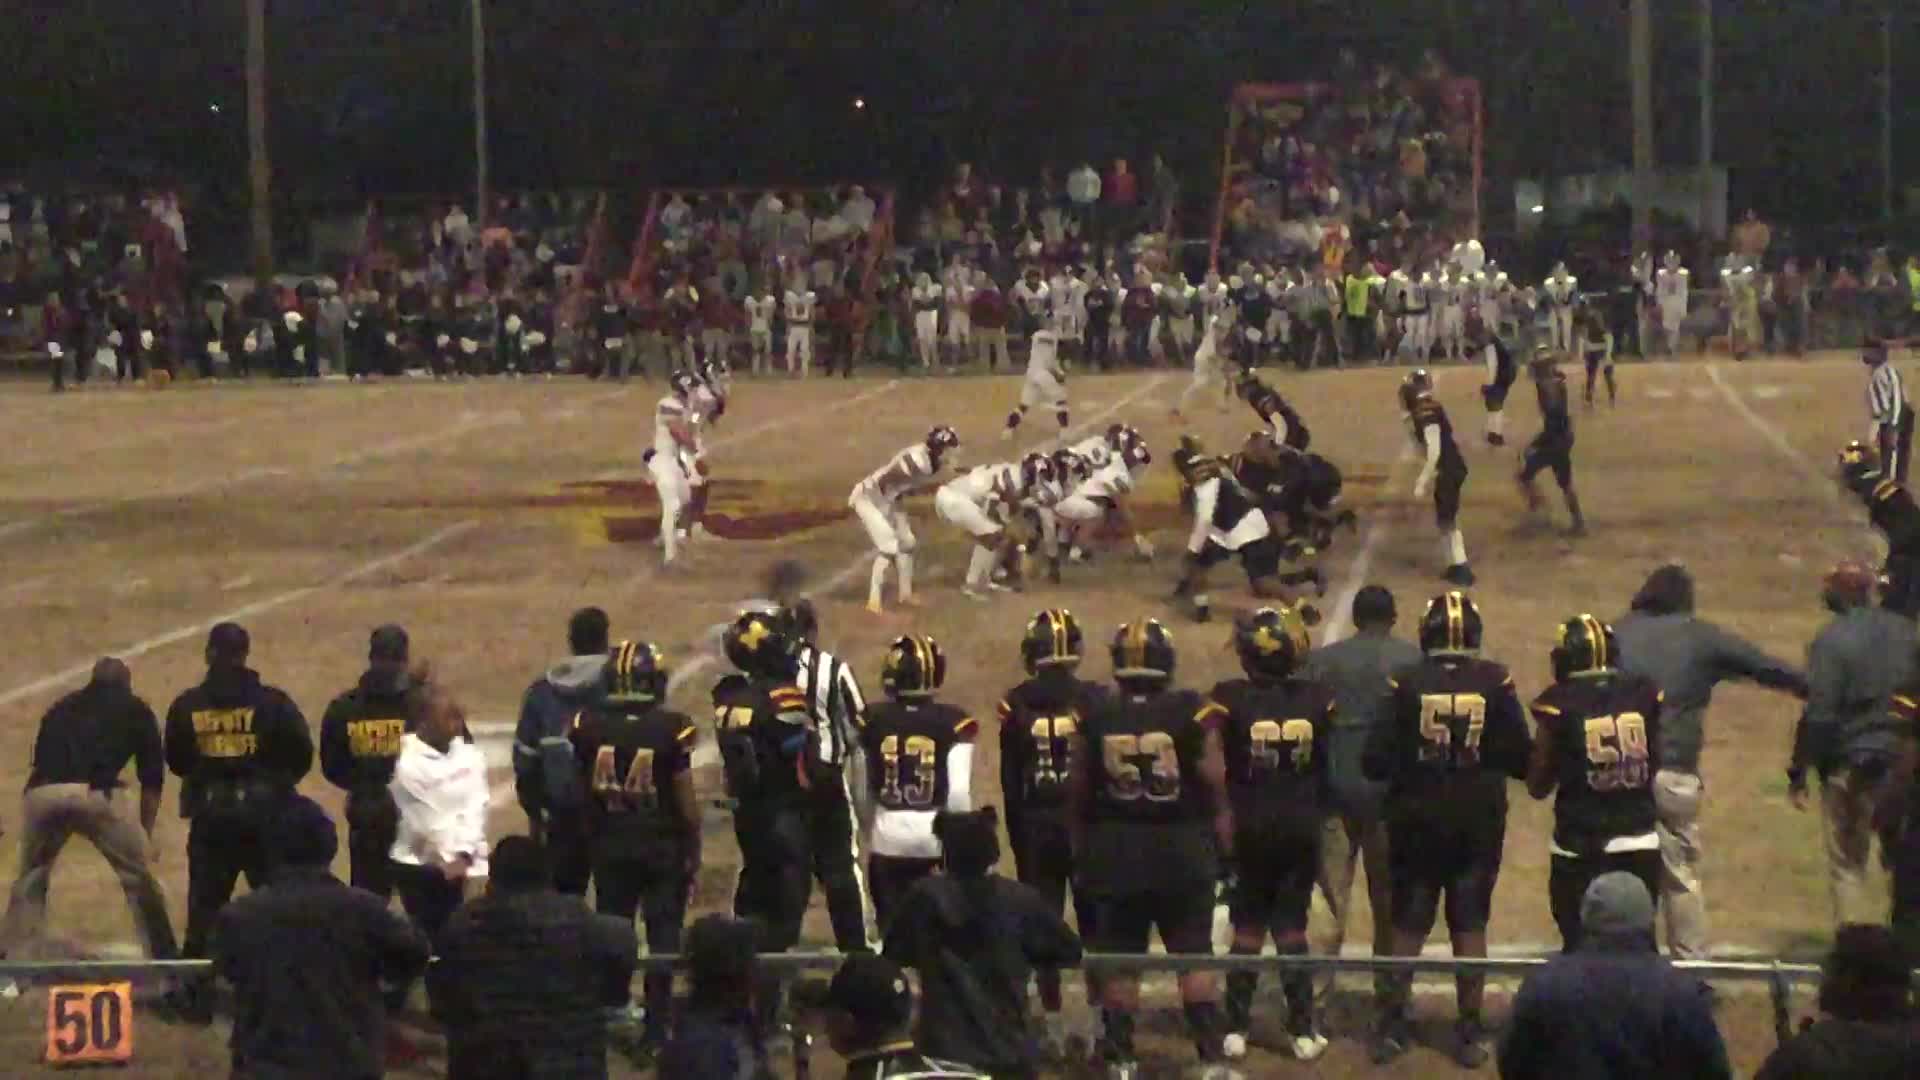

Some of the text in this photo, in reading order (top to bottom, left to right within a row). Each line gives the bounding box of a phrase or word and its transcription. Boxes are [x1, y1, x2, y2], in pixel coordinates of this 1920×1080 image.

[1419, 693, 1486, 764] 57
[591, 744, 656, 806] 44
[880, 735, 936, 806] 13
[1103, 732, 1180, 801] 53
[55, 990, 122, 1055] 50
